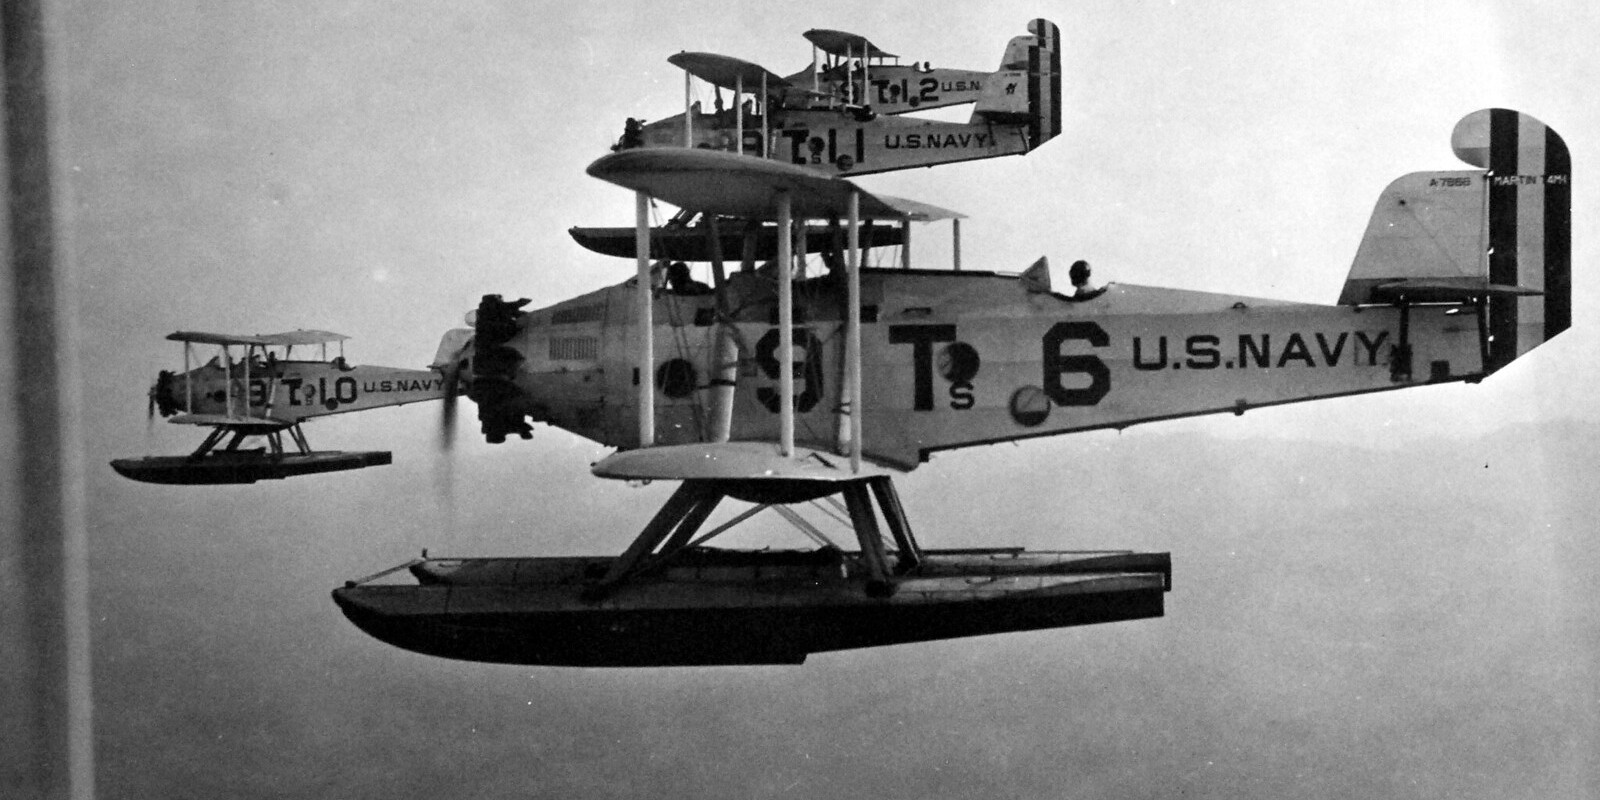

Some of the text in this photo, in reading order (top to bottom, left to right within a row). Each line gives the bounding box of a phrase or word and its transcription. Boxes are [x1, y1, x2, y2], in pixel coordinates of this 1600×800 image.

[885, 133, 988, 149] U.S.NAVY
[1494, 175, 1536, 186] MARTIN
[755, 328, 824, 414] 9
[1042, 321, 1111, 407] 6
[1132, 330, 1389, 371] U.S.NAVY
[364, 378, 445, 393] U.S.NAVY
